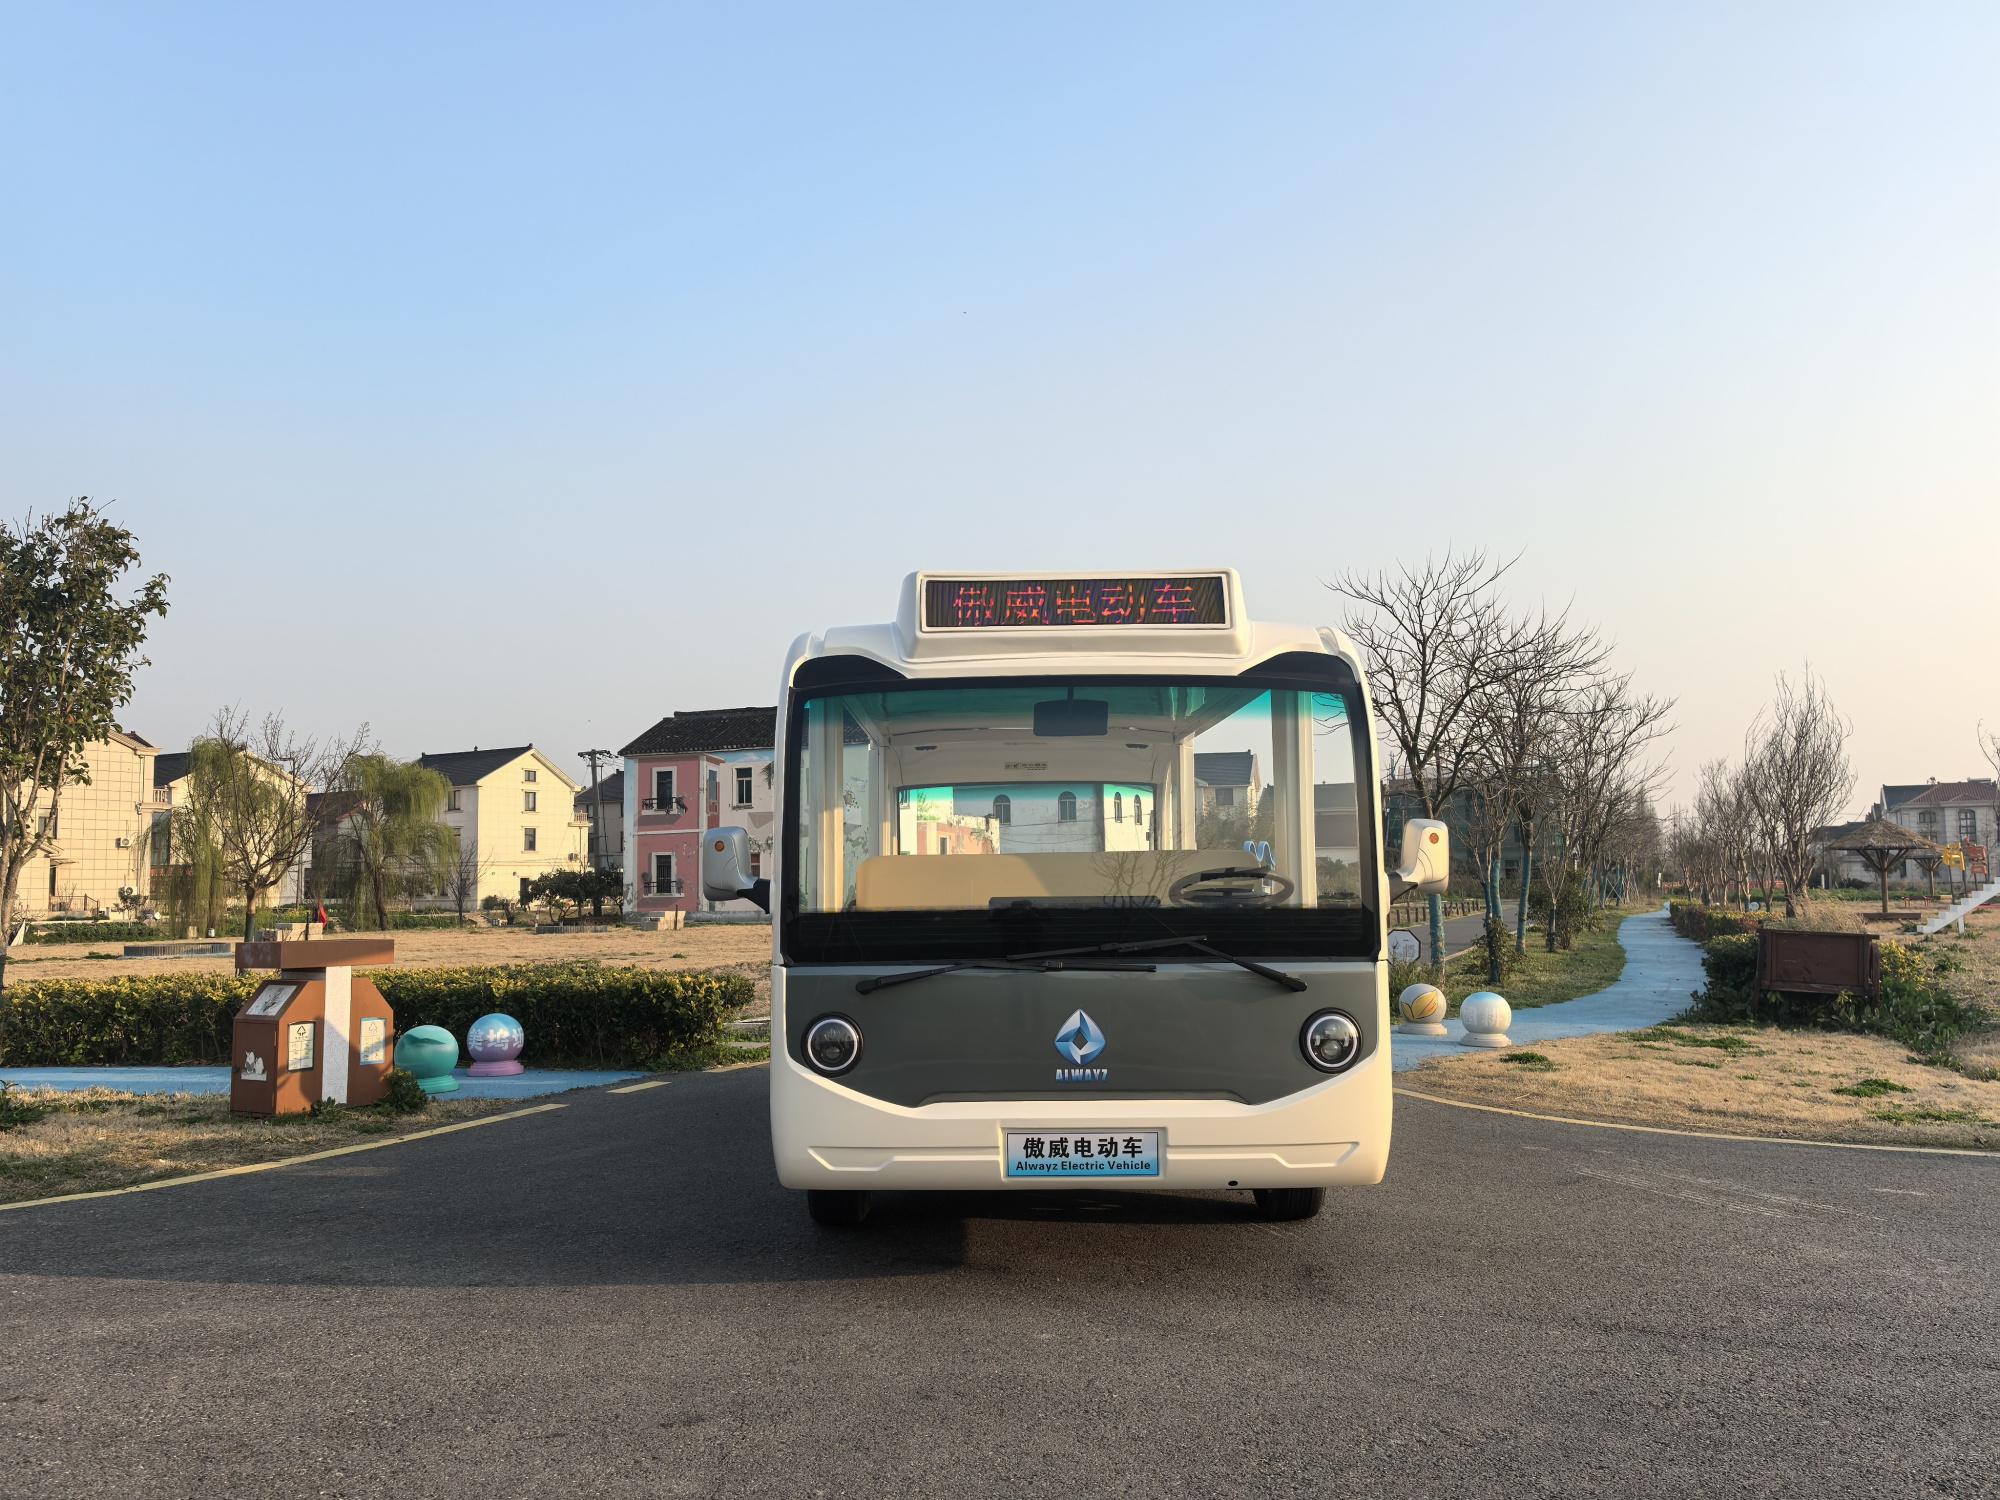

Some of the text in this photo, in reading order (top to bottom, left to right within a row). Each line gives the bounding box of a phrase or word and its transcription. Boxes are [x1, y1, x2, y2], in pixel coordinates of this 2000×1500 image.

[1056, 1068, 1108, 1081] ALWAYZ
[1022, 1136, 1143, 1159] 傲威电动车
[1015, 1160, 1151, 1172] Alwayz Electric Vehicle
